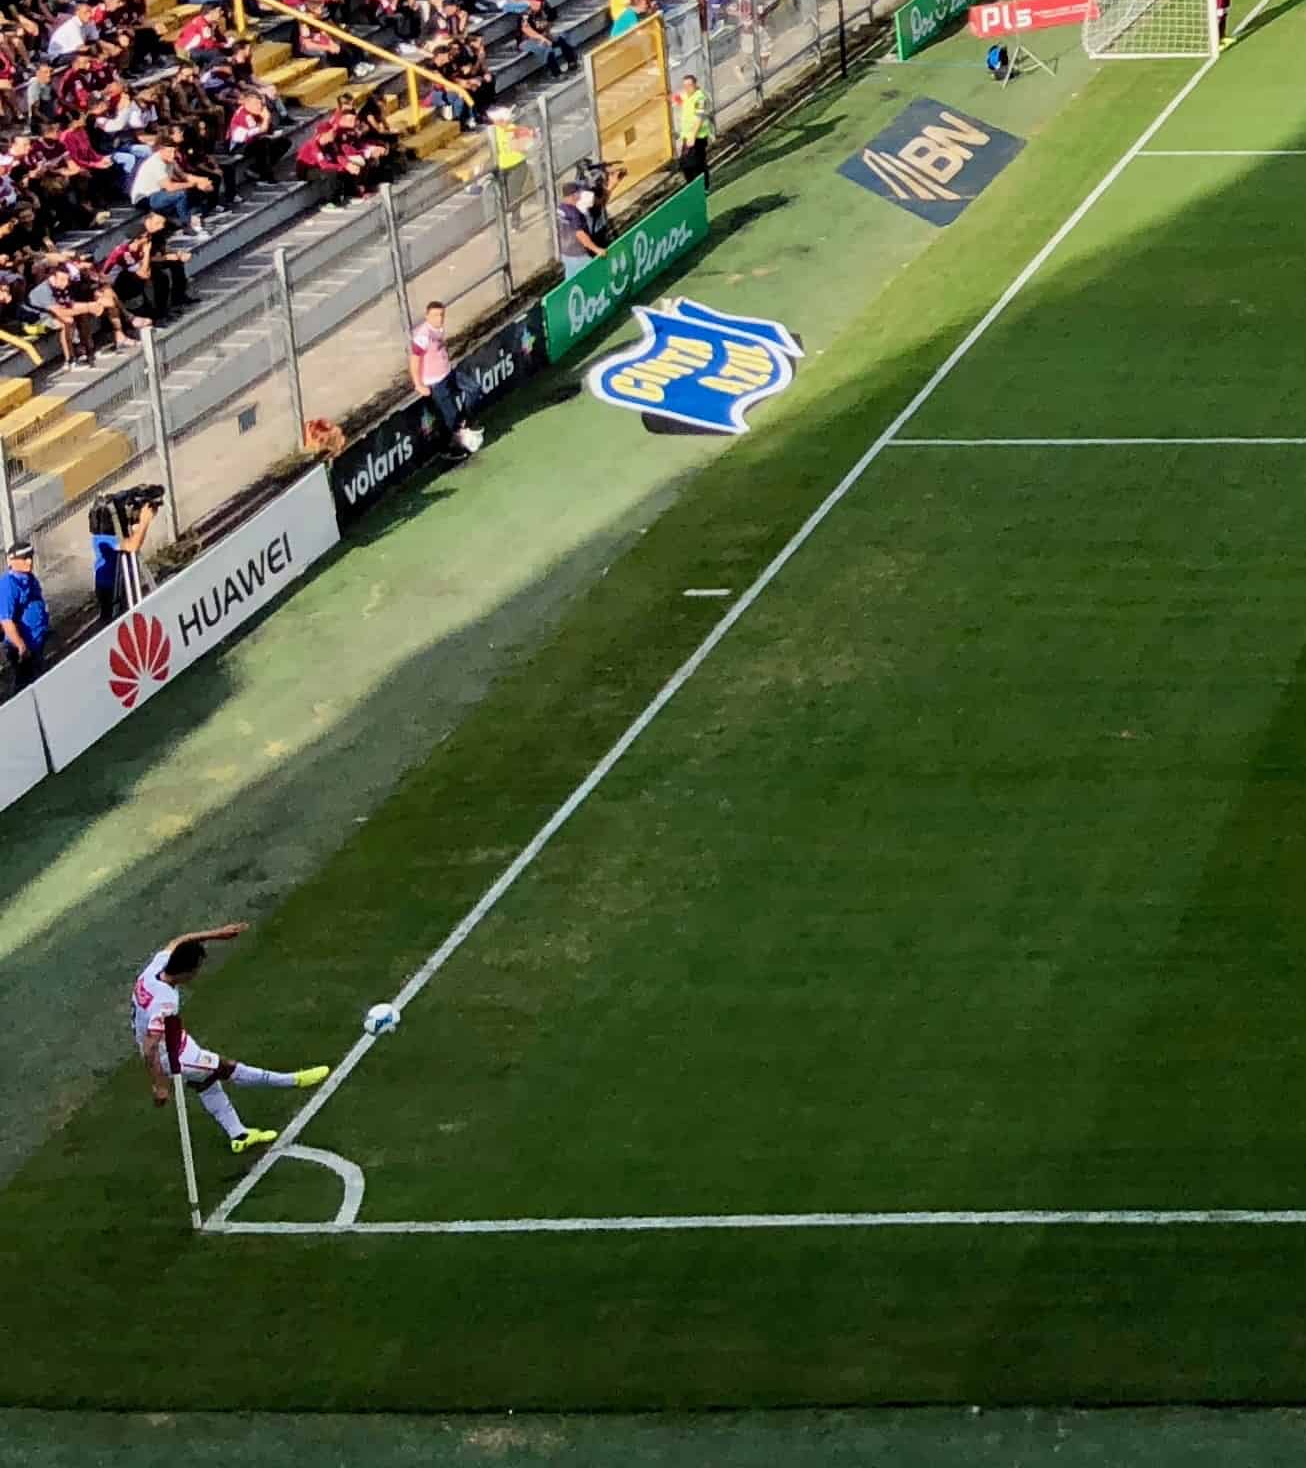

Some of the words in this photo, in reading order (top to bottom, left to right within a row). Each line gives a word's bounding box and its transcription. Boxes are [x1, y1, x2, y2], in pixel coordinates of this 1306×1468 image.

[910, 7, 936, 44] Dos
[897, 111, 991, 185] BN
[568, 284, 610, 336] Dos
[633, 219, 694, 291] Pinos
[455, 348, 514, 412] vlaris
[609, 334, 713, 403] CINTA
[699, 339, 773, 396] AZUL
[343, 434, 413, 506] volaris
[178, 531, 293, 646] HUAWEI
